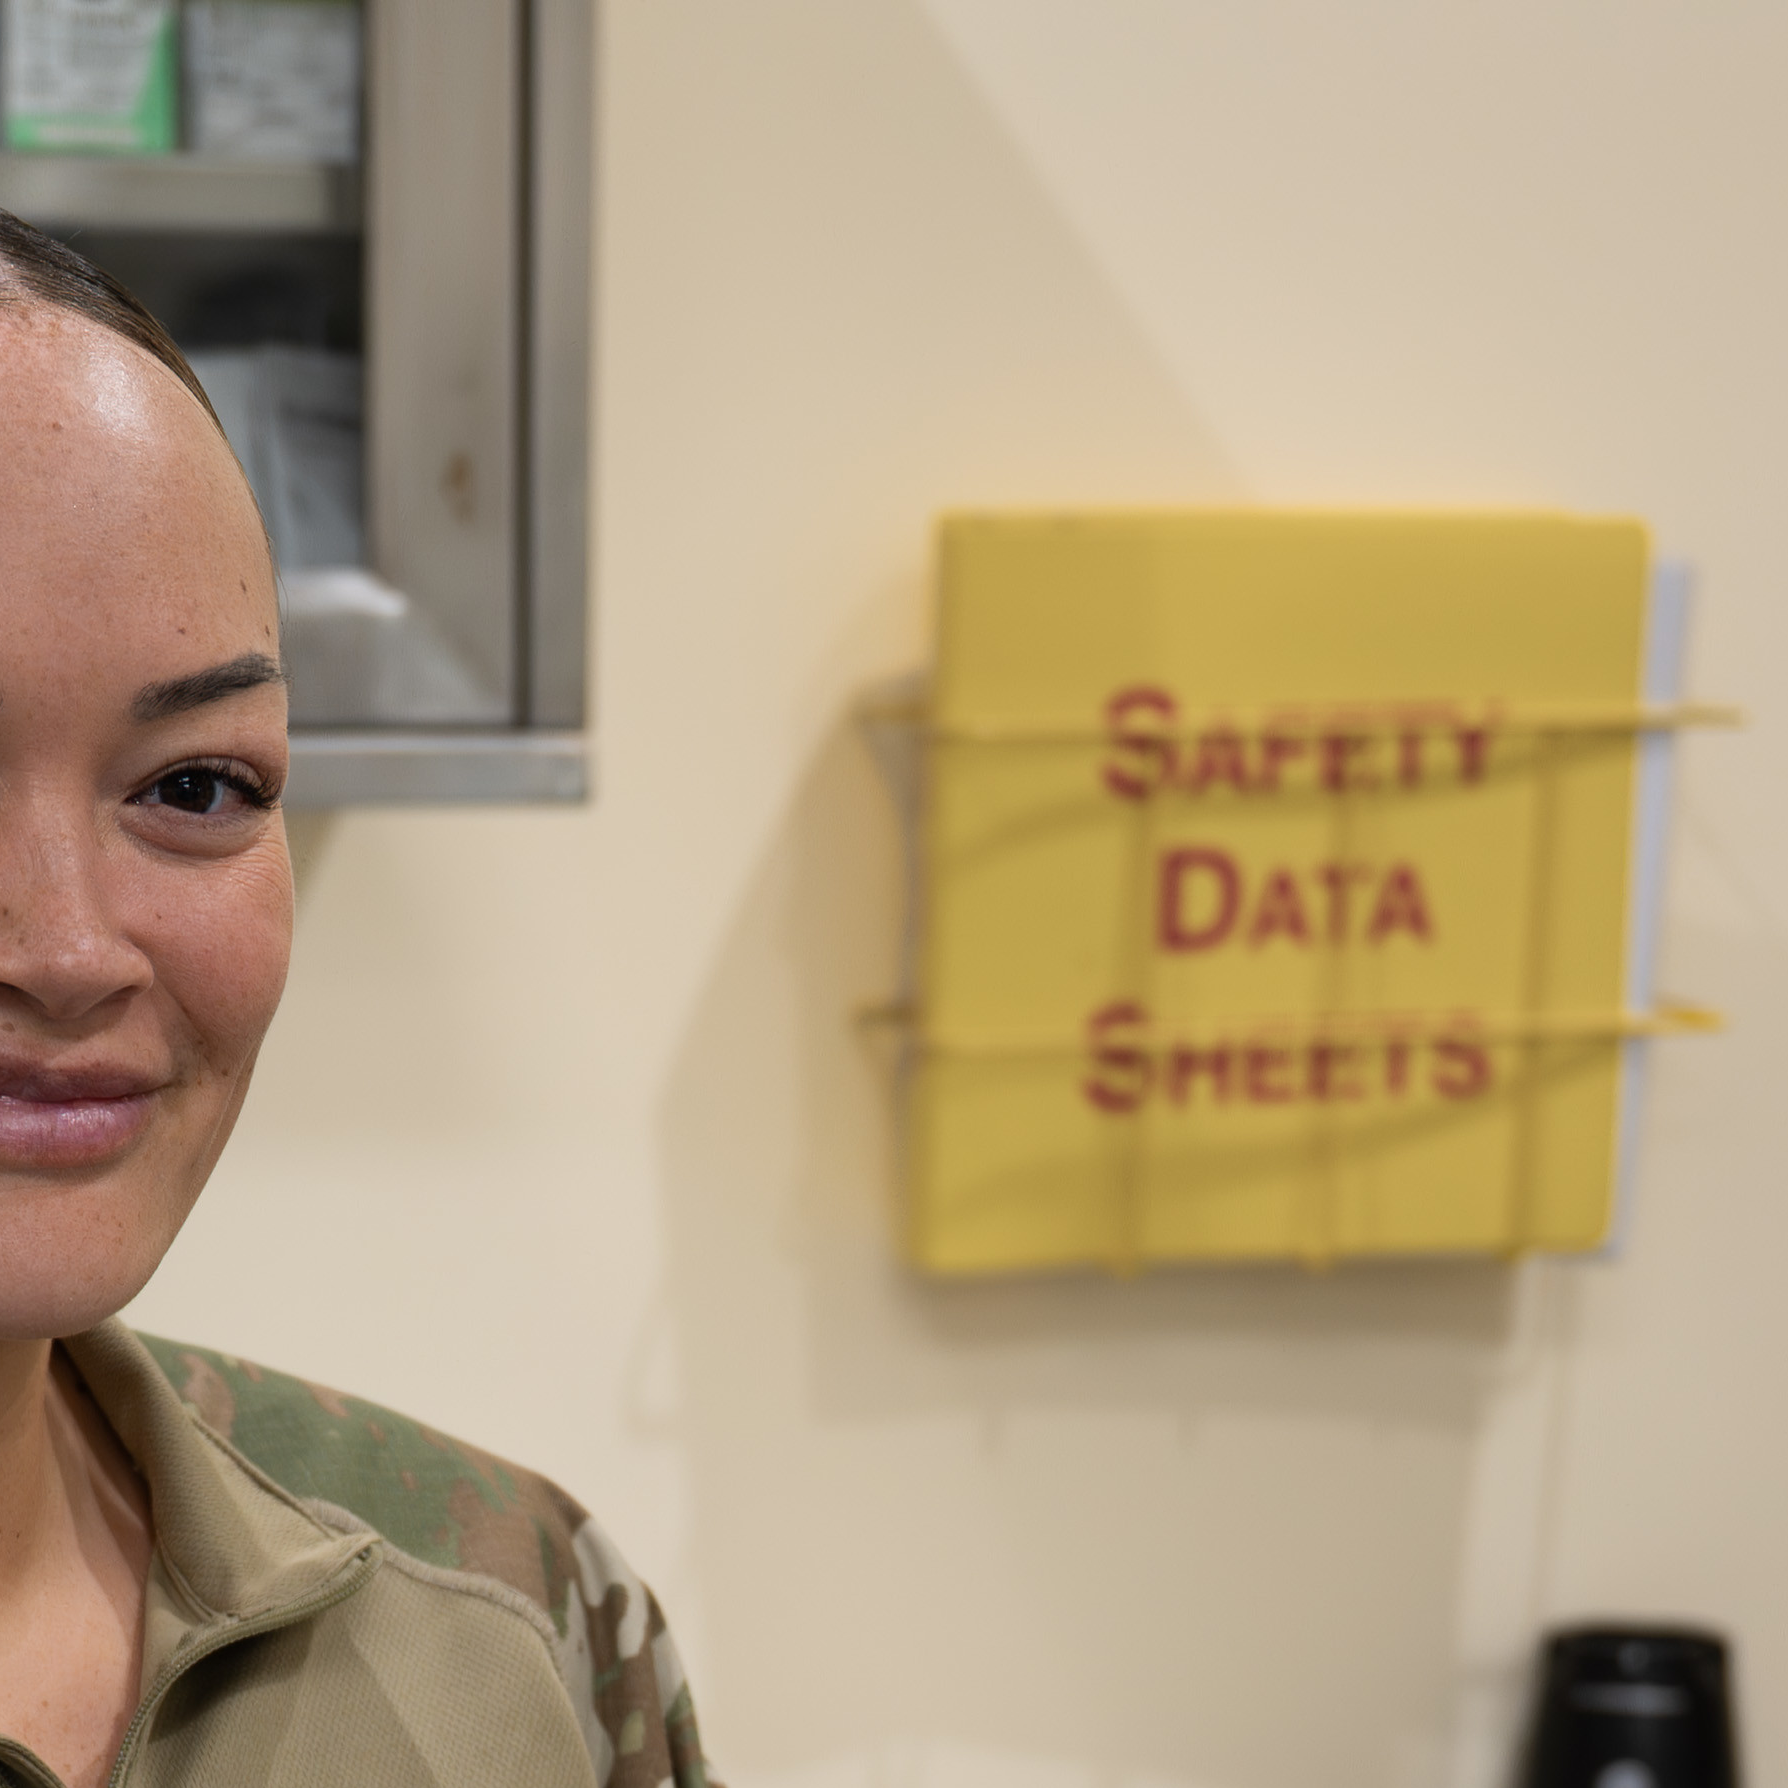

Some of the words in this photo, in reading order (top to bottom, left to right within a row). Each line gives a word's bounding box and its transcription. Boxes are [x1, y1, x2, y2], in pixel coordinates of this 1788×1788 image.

[1100, 684, 1505, 801] SAFETY
[1156, 844, 1436, 956] DATA
[1084, 999, 1494, 1115] SHEETS
